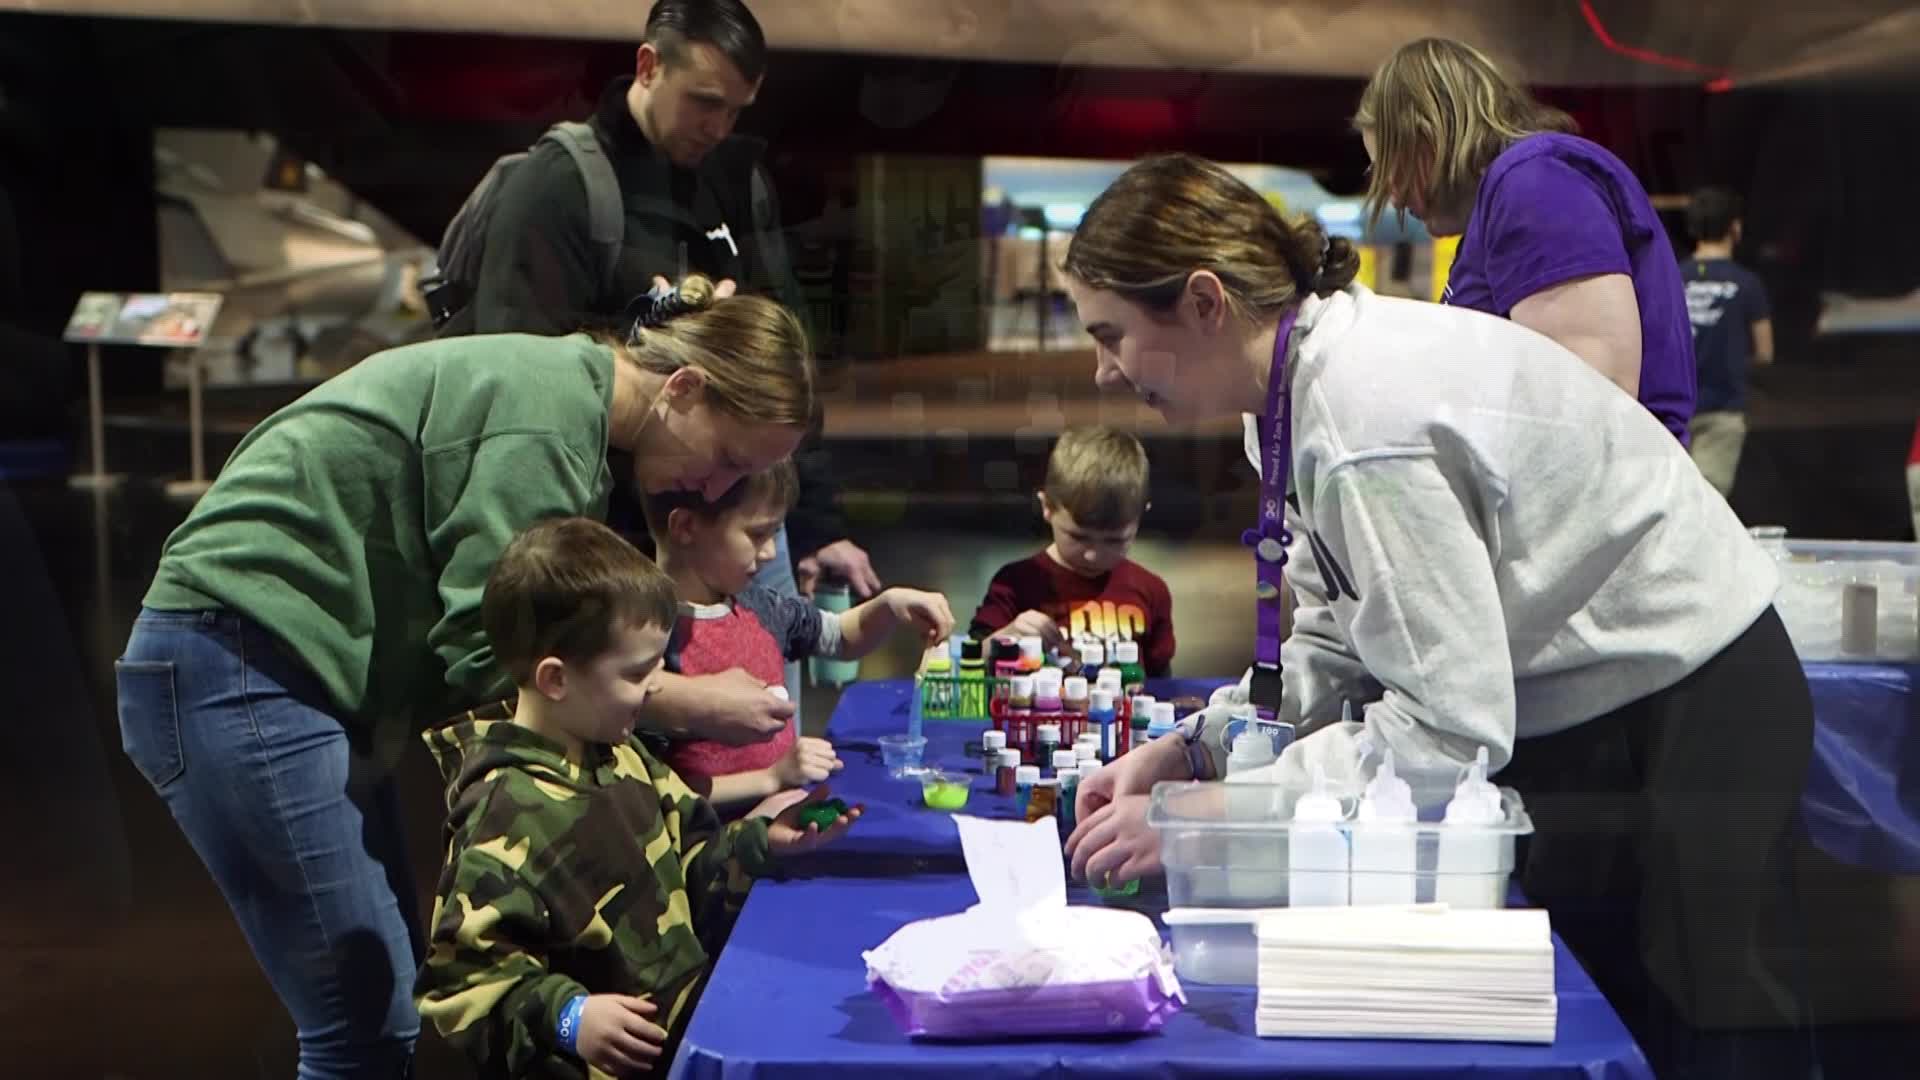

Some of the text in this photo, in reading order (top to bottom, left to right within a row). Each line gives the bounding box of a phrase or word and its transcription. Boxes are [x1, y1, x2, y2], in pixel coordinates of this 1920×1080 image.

[1272, 422, 1283, 440] Zoo
[1271, 442, 1281, 458] Air
[1270, 460, 1281, 486] Proud
